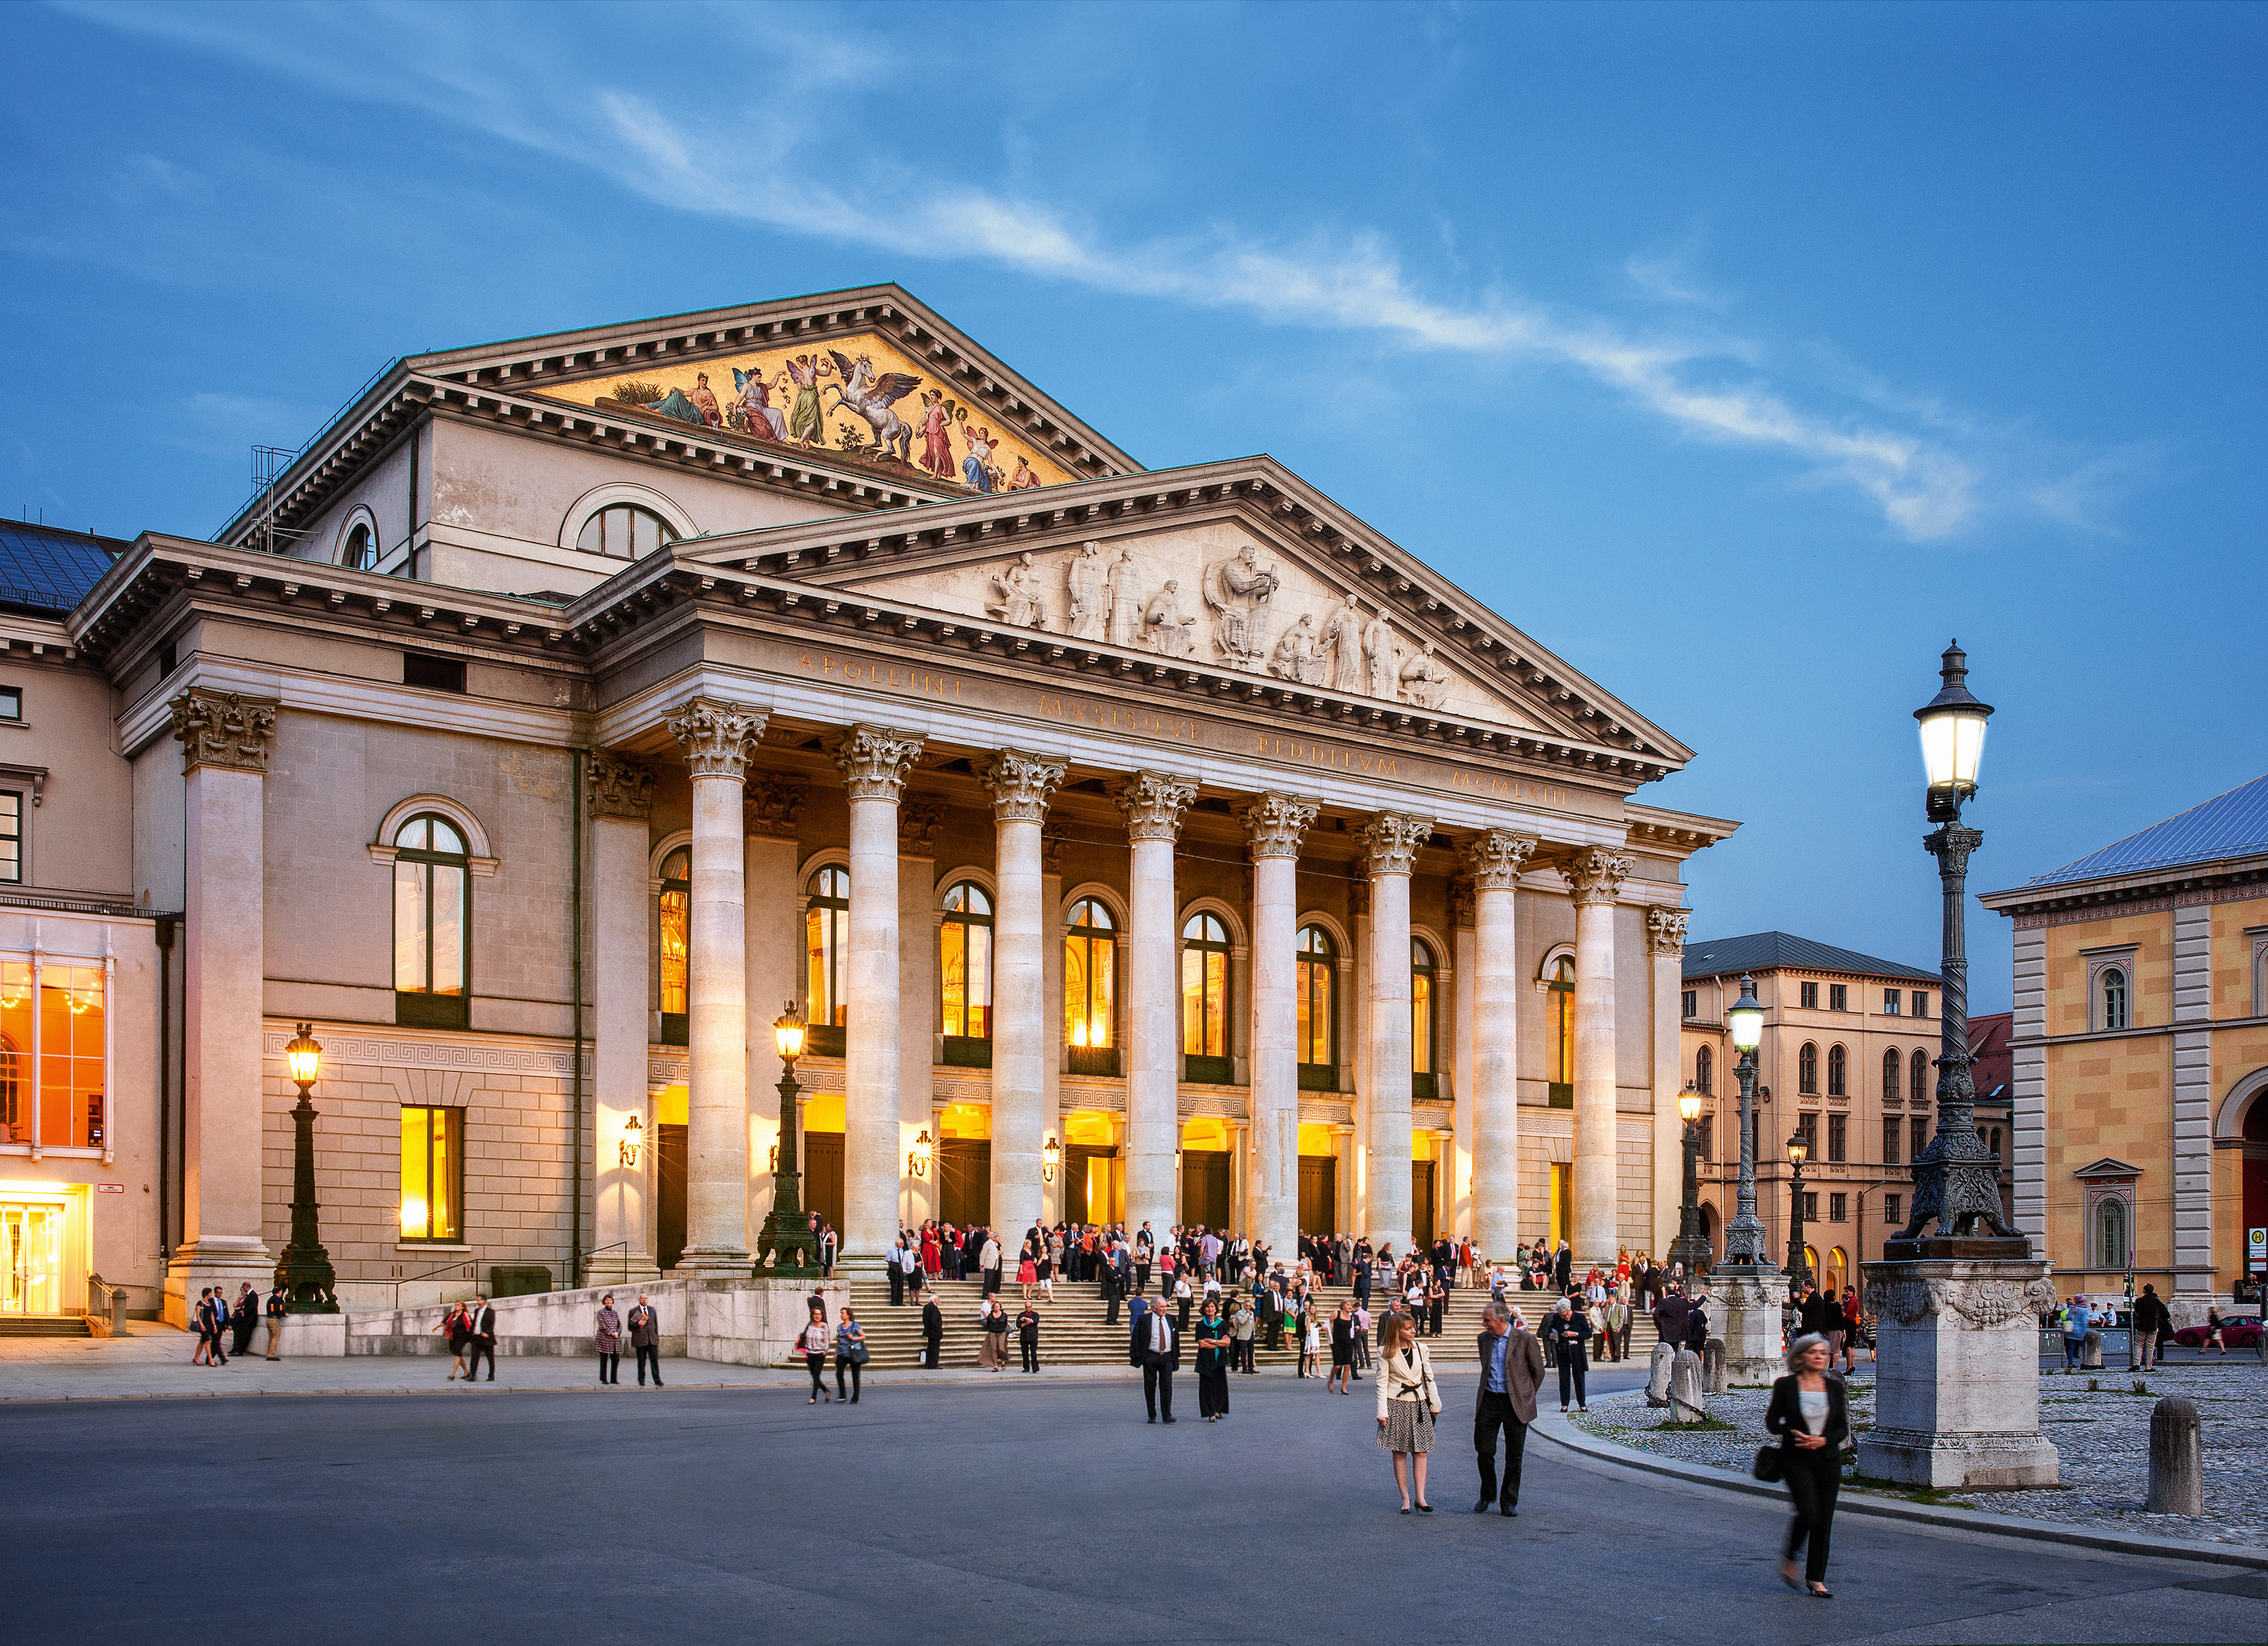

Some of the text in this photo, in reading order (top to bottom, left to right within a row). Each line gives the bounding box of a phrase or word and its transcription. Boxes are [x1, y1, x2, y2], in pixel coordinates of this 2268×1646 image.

[798, 653, 1566, 806] APOLLINI MVSISQVE REDDITVM MCMLXIII
